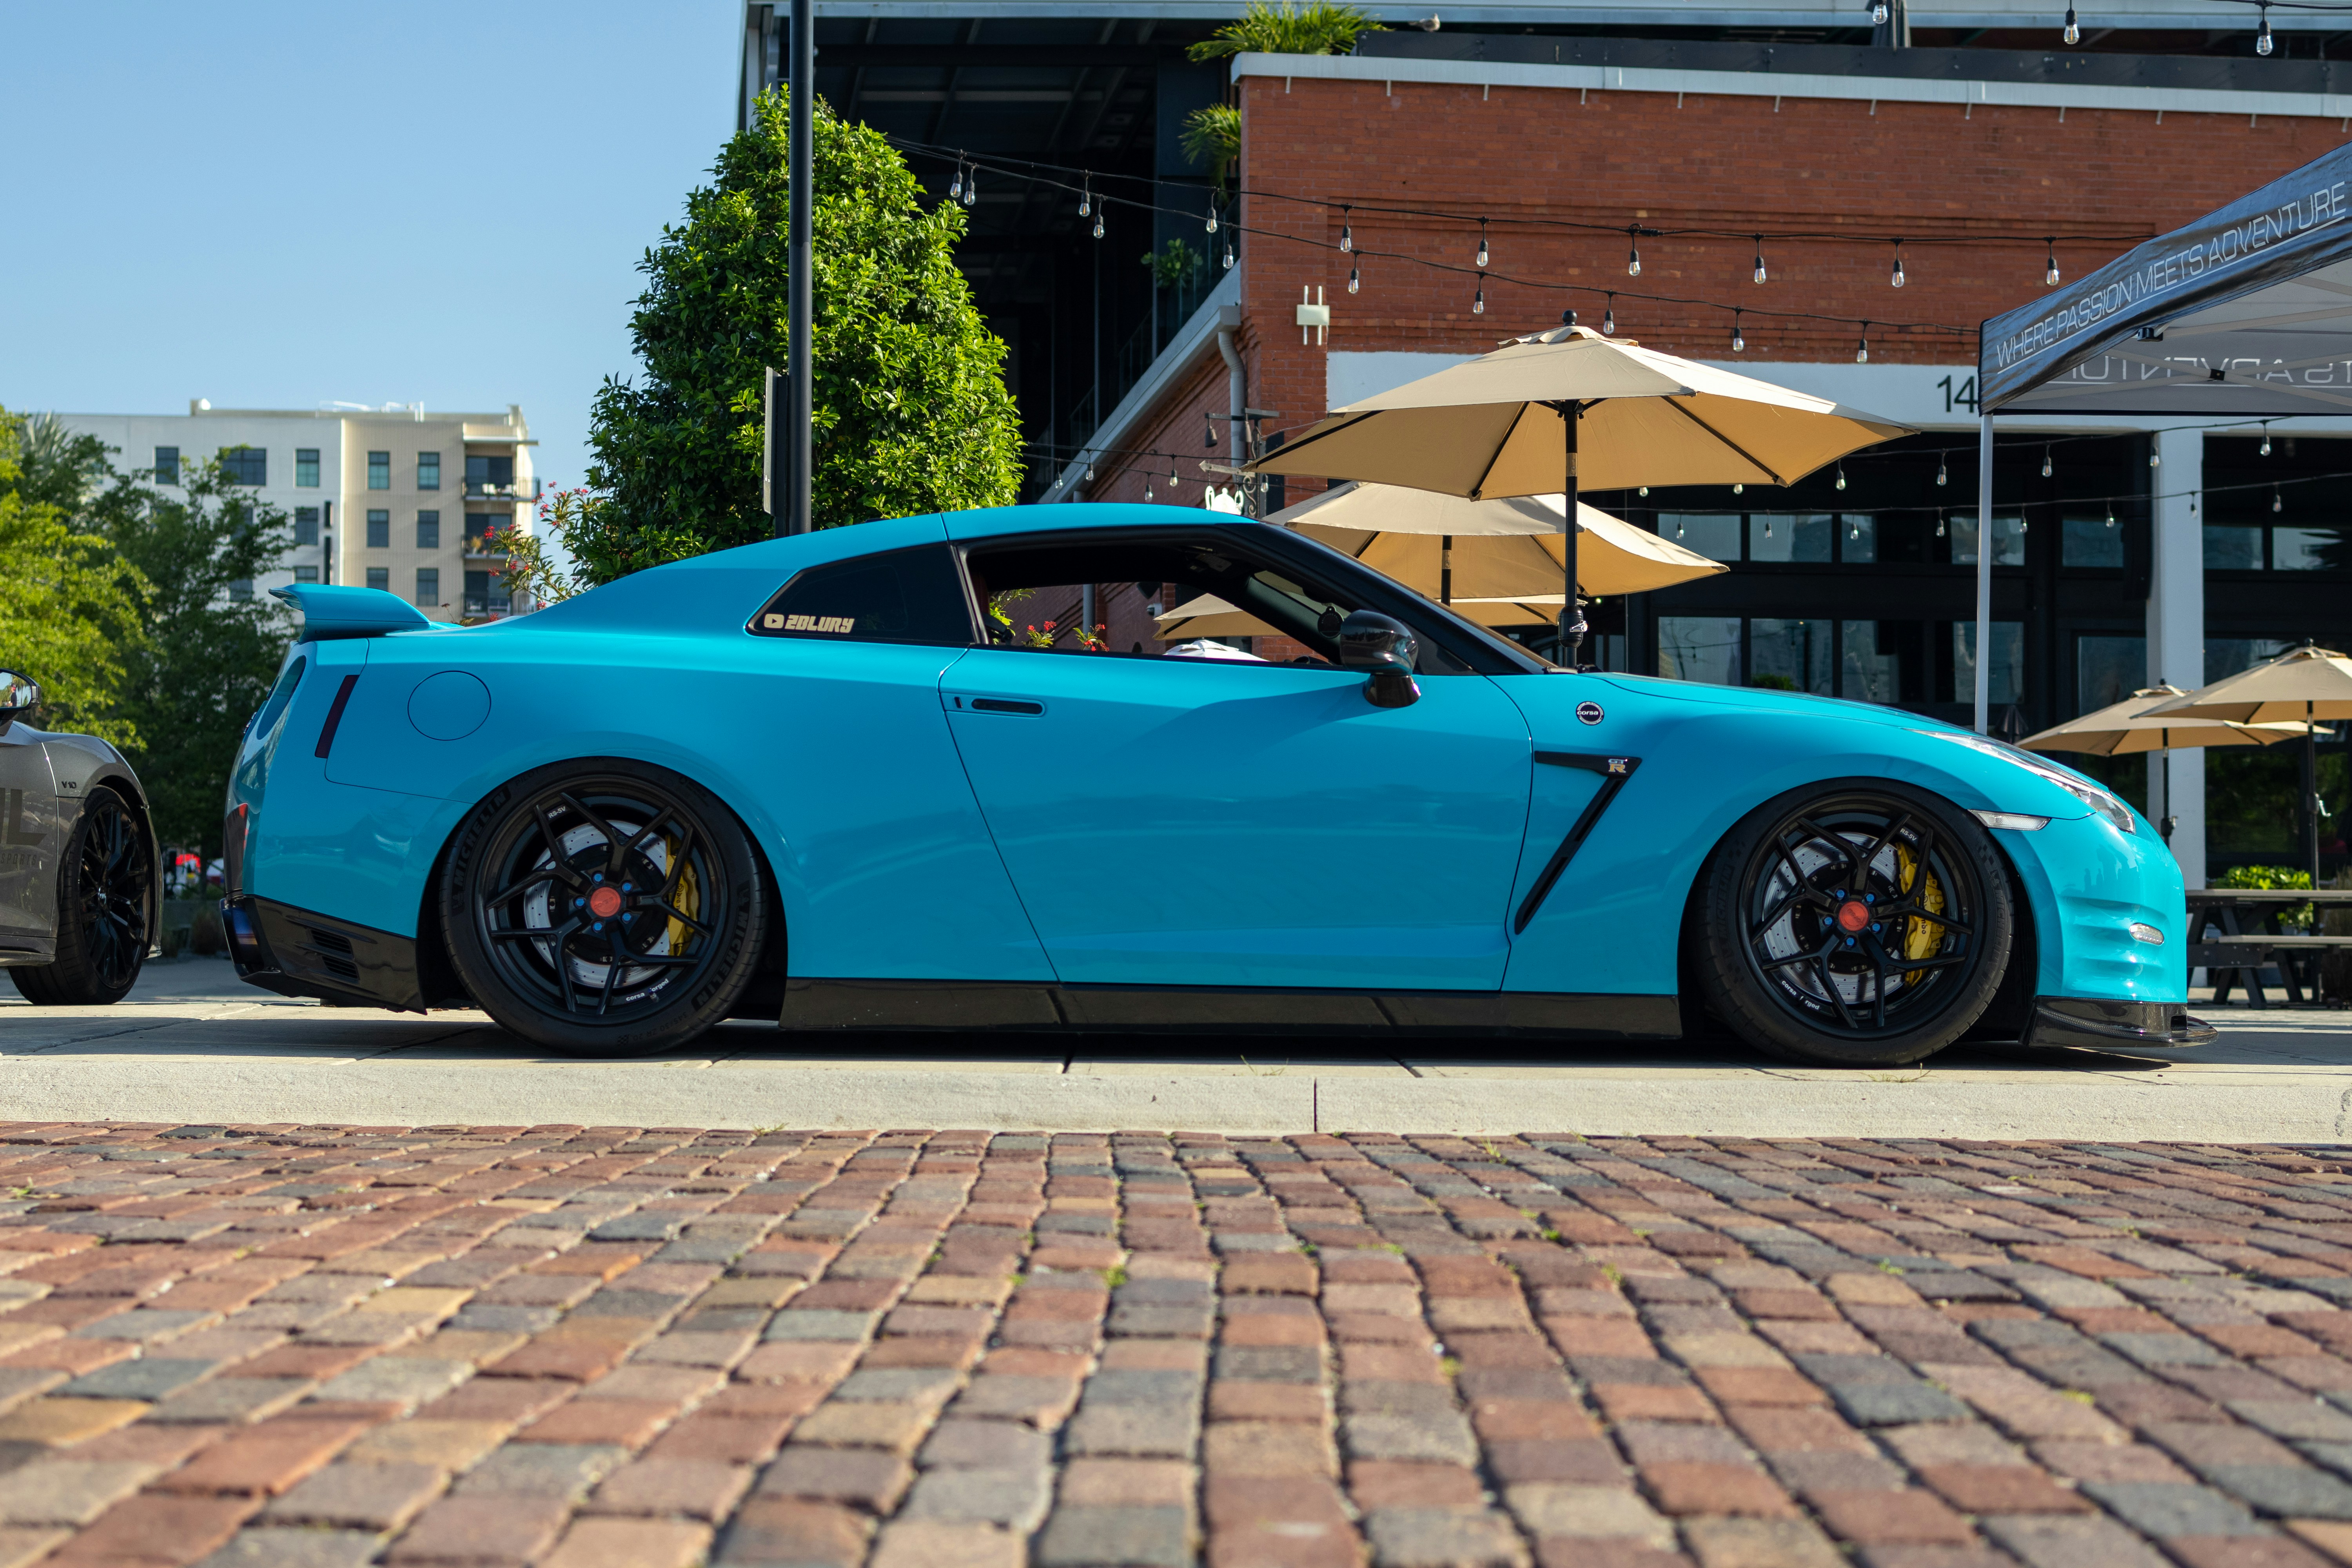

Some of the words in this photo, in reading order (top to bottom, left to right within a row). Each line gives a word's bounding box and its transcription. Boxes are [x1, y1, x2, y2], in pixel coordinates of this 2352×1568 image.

[1997, 316, 2054, 367] WHERE
[2056, 276, 2132, 338] PASSION
[2136, 244, 2204, 299] MEETS
[2209, 181, 2347, 268] ADVENTURE
[515, 769, 541, 787] PILOT
[548, 806, 565, 818] RS-5V
[454, 789, 506, 886] MICHELIN
[1900, 827, 1917, 841] RS-5V
[698, 913, 748, 1006] MICHELIN
[626, 993, 645, 1001] corsa
[649, 978, 669, 991] orged
[1782, 981, 1797, 996] corsa
[1800, 996, 1820, 1010] frged
